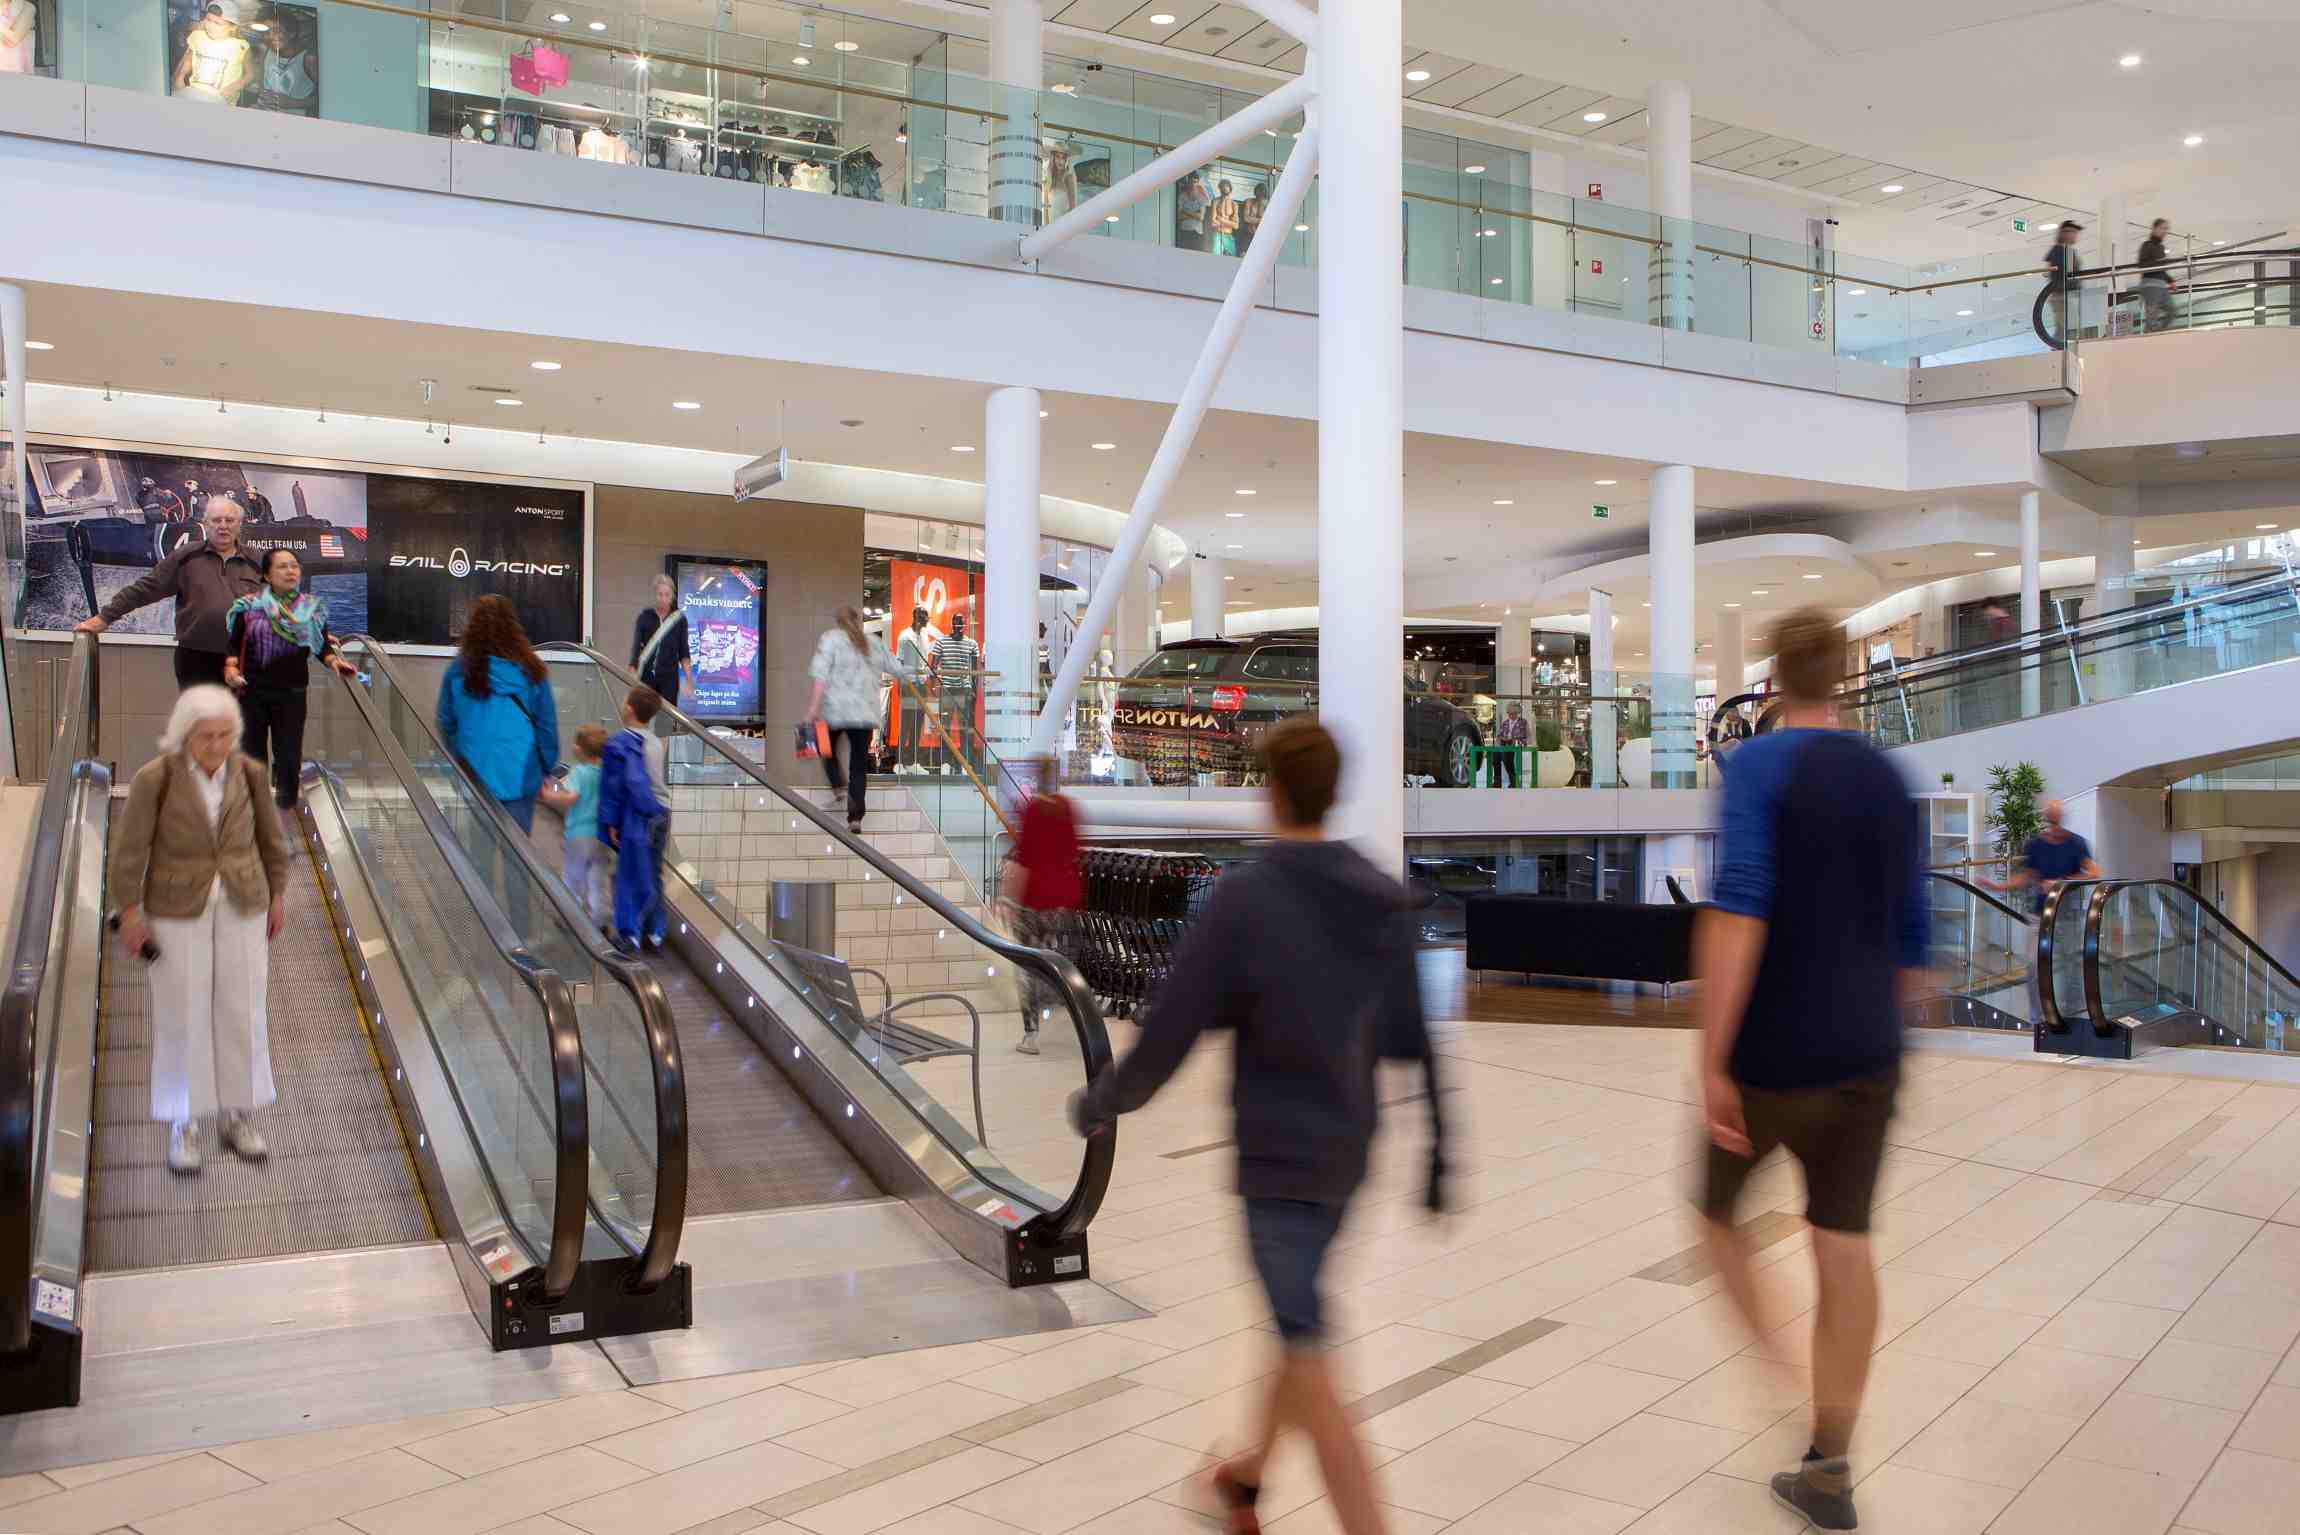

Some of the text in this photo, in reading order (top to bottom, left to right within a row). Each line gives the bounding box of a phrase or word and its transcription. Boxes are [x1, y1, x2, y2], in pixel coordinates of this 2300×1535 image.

[514, 506, 565, 517] ANTONSPORT
[247, 540, 308, 550] ORACLE TEAM USA
[389, 555, 445, 569] SAIL
[1695, 697, 1716, 712] ATCH
